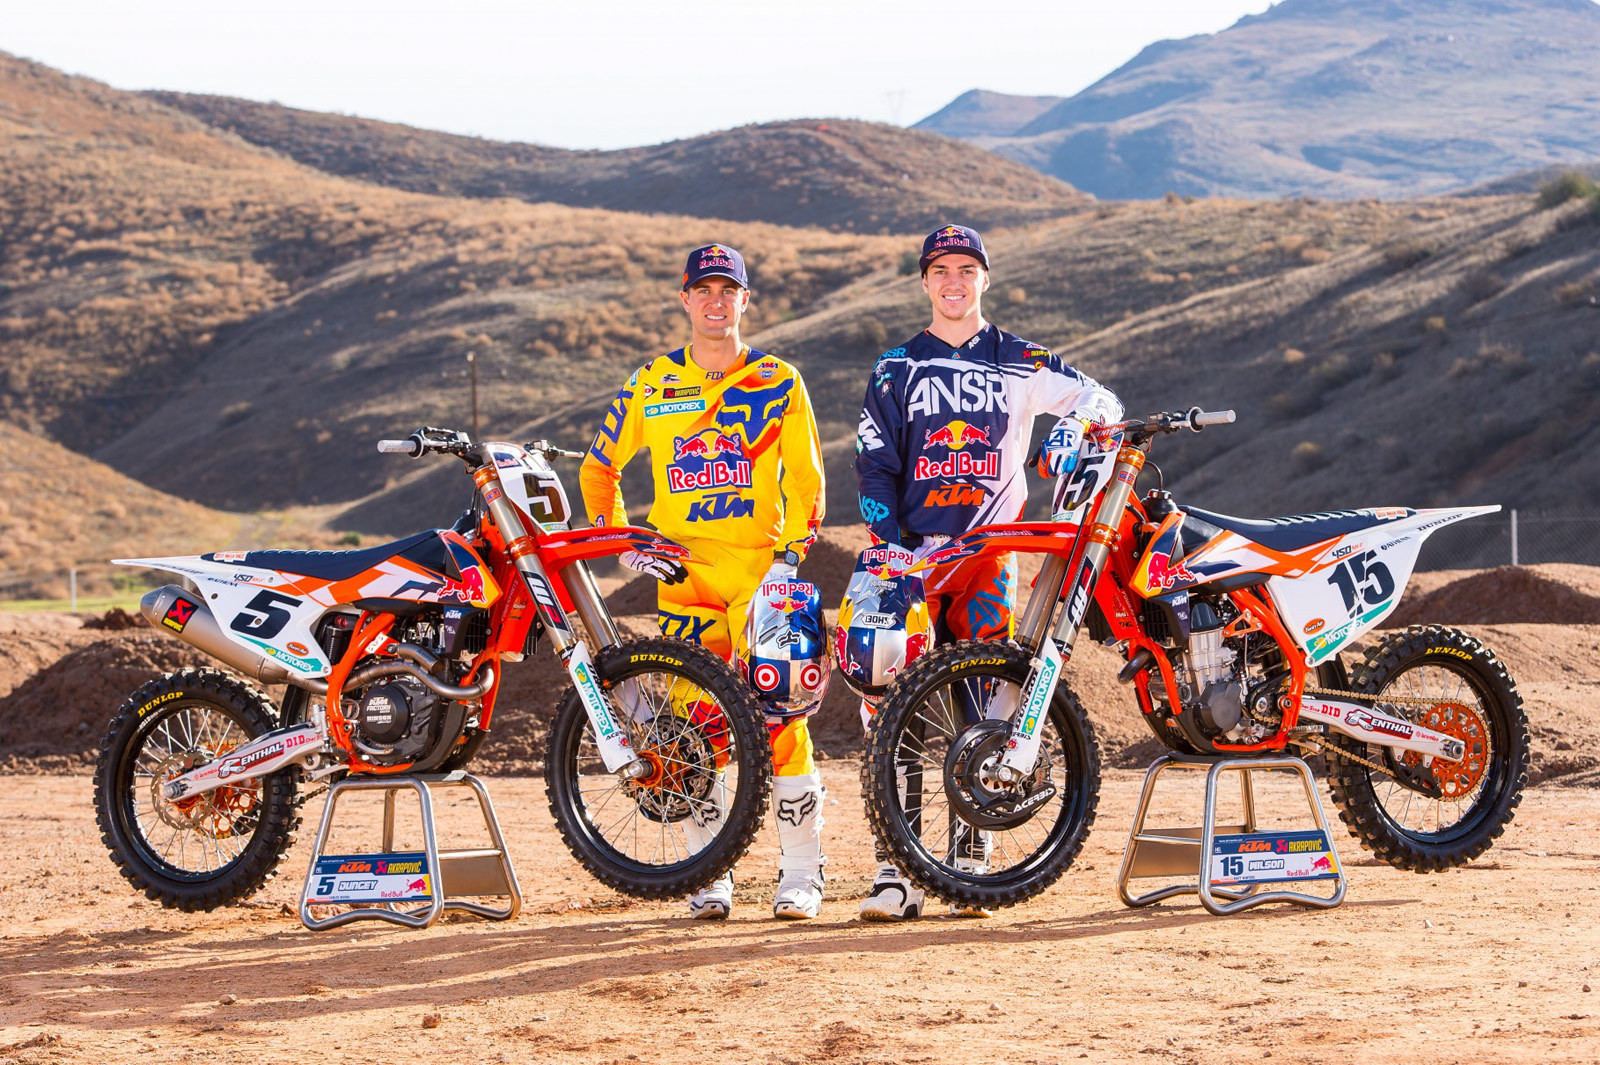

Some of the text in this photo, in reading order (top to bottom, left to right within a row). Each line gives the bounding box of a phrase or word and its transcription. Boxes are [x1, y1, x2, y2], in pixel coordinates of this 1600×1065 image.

[699, 257, 735, 270] Red Bull
[705, 371, 726, 381] FOX
[907, 370, 1009, 422] ANSR
[660, 401, 702, 413] MOTOREX
[590, 388, 634, 467] FOX
[858, 408, 885, 451] TM
[669, 461, 751, 491] Red Bull
[915, 452, 999, 481] Red Bull
[522, 472, 566, 523] 5
[923, 483, 985, 507] KTM
[685, 491, 755, 522] KTM
[1417, 513, 1464, 532] DUNLOP
[862, 550, 914, 566] Red Bull
[1332, 545, 1352, 558] 450
[234, 573, 254, 583] 450
[1327, 550, 1395, 619] 15
[762, 583, 814, 596] Red Bull
[230, 590, 303, 639] 5
[445, 609, 462, 620] KTM
[1324, 619, 1366, 645] MOTOEX
[276, 650, 314, 672] MOTOREX
[630, 654, 683, 667] DUNLOP
[1425, 646, 1473, 661] DUNLOP
[951, 658, 1007, 673] DUNLOP
[1028, 664, 1055, 718] MOTOREX
[138, 691, 184, 718] DUNLOP
[582, 681, 613, 736] MOTOREX
[1321, 704, 1341, 718] DID
[286, 735, 305, 748] DID
[1012, 787, 1055, 814] ACERBIS
[1238, 840, 1272, 852] KTM
[338, 861, 372, 873] KTM
[1220, 856, 1284, 876] 15 WILSON
[316, 876, 336, 895] 5
[381, 890, 392, 898] Red
